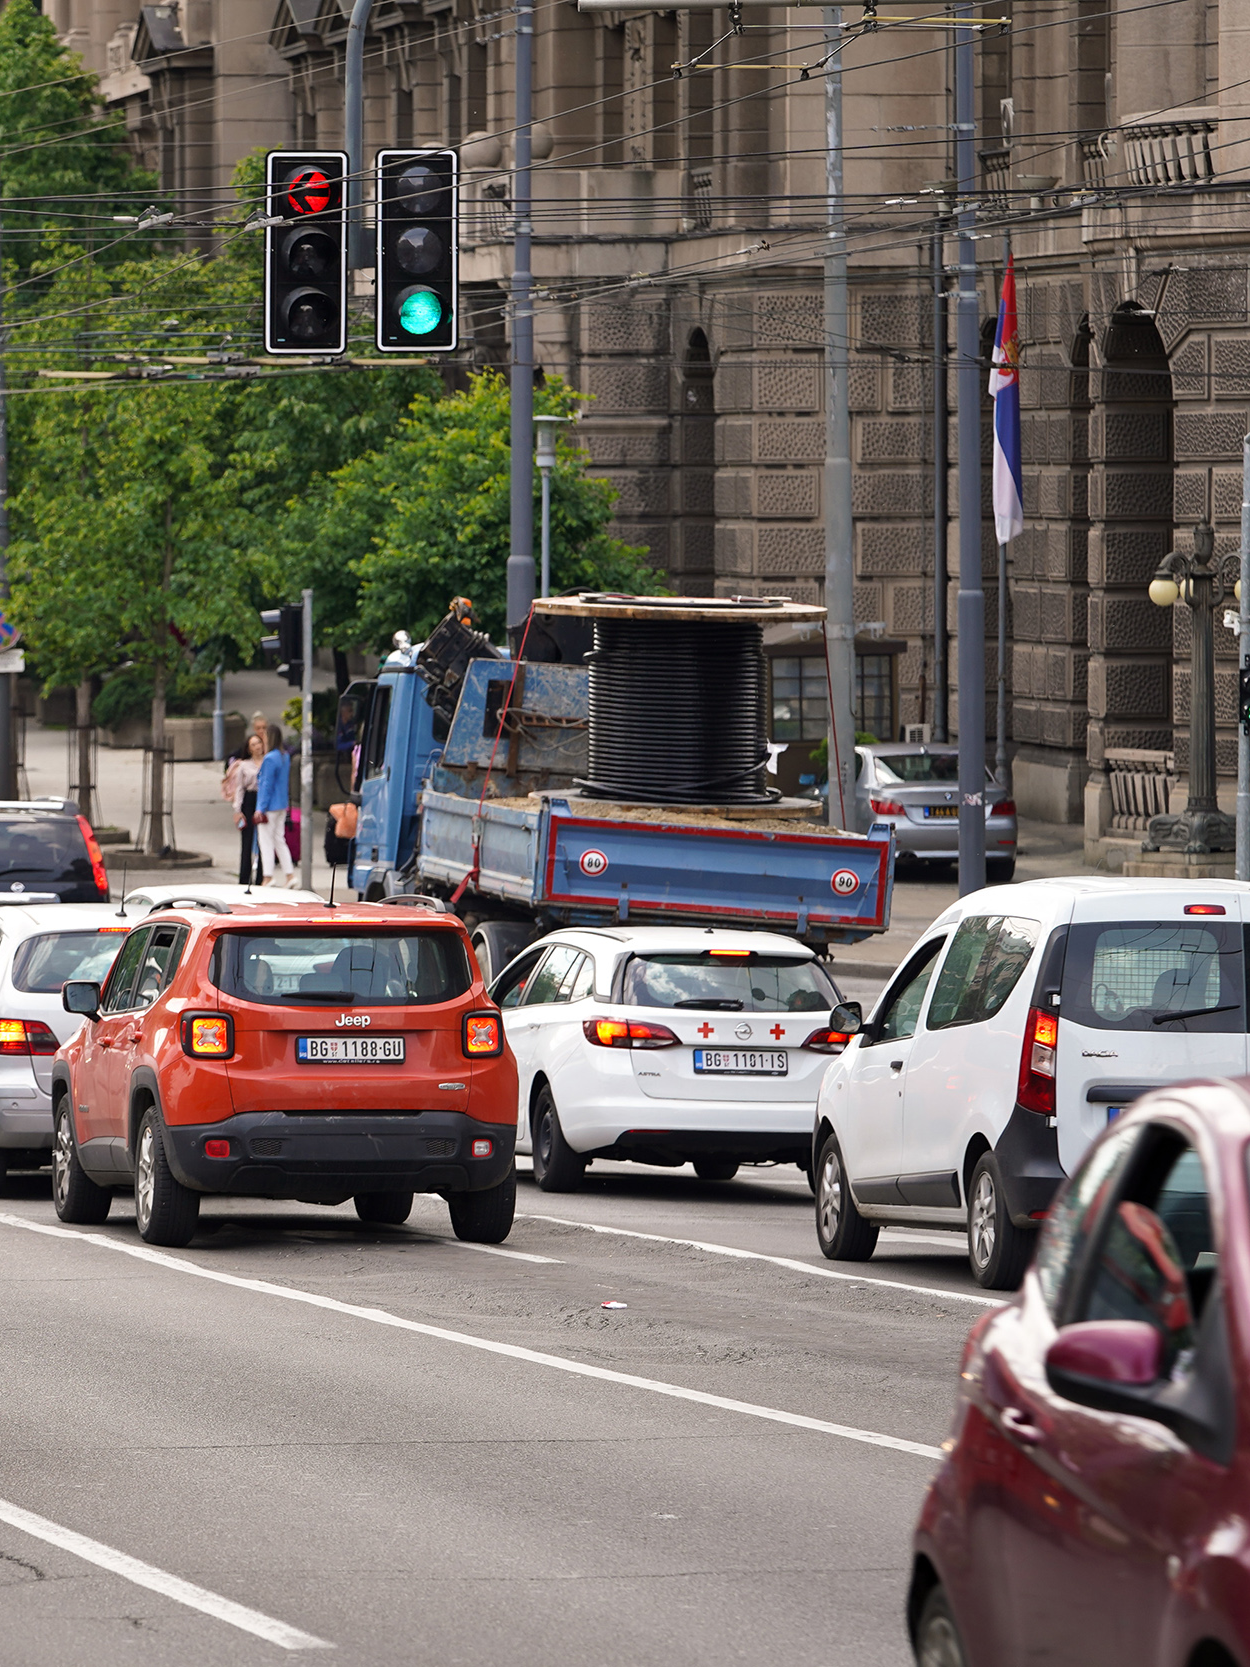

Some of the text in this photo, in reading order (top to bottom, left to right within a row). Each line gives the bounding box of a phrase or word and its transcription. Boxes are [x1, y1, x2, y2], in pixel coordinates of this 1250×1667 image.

[587, 857, 601, 868] 80
[838, 876, 853, 888] 90
[335, 1014, 371, 1028] Jeep
[310, 1040, 328, 1057] BG
[705, 1052, 721, 1067] BG
